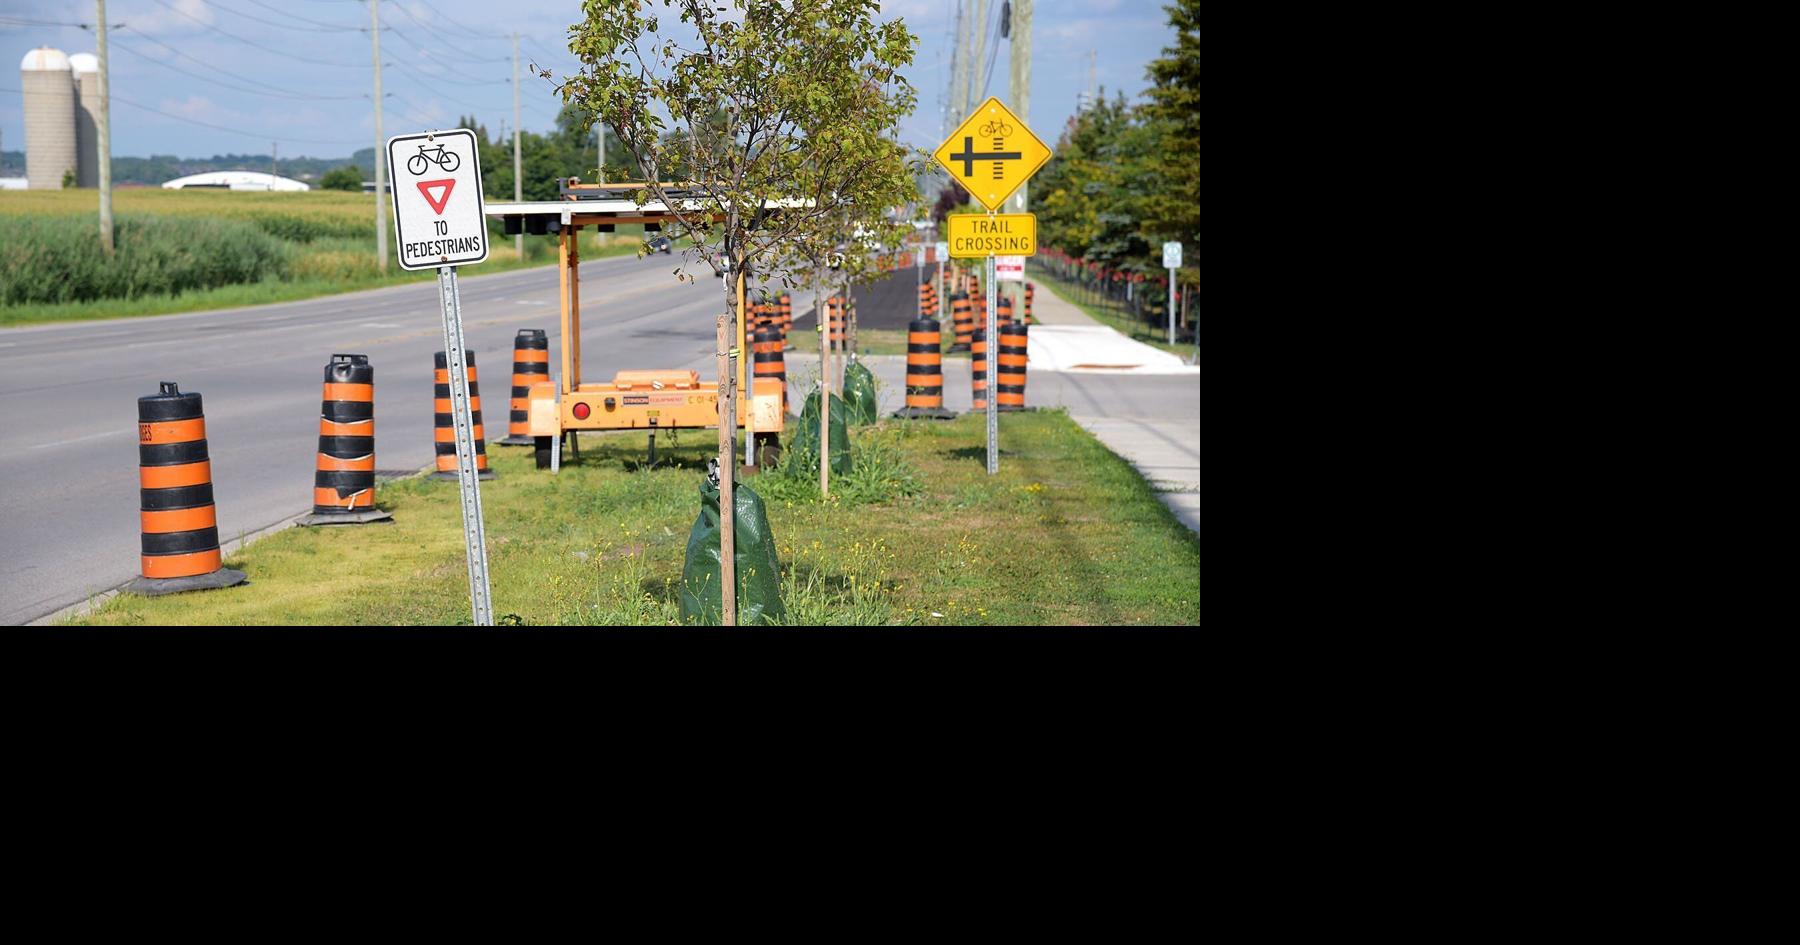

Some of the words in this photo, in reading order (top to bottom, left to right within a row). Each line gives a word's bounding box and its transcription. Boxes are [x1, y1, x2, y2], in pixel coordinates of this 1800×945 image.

[434, 220, 448, 236] TO
[972, 221, 1012, 233] TRAIL
[406, 236, 480, 259] PEDESTRIANS
[955, 237, 1029, 251] CROSSING
